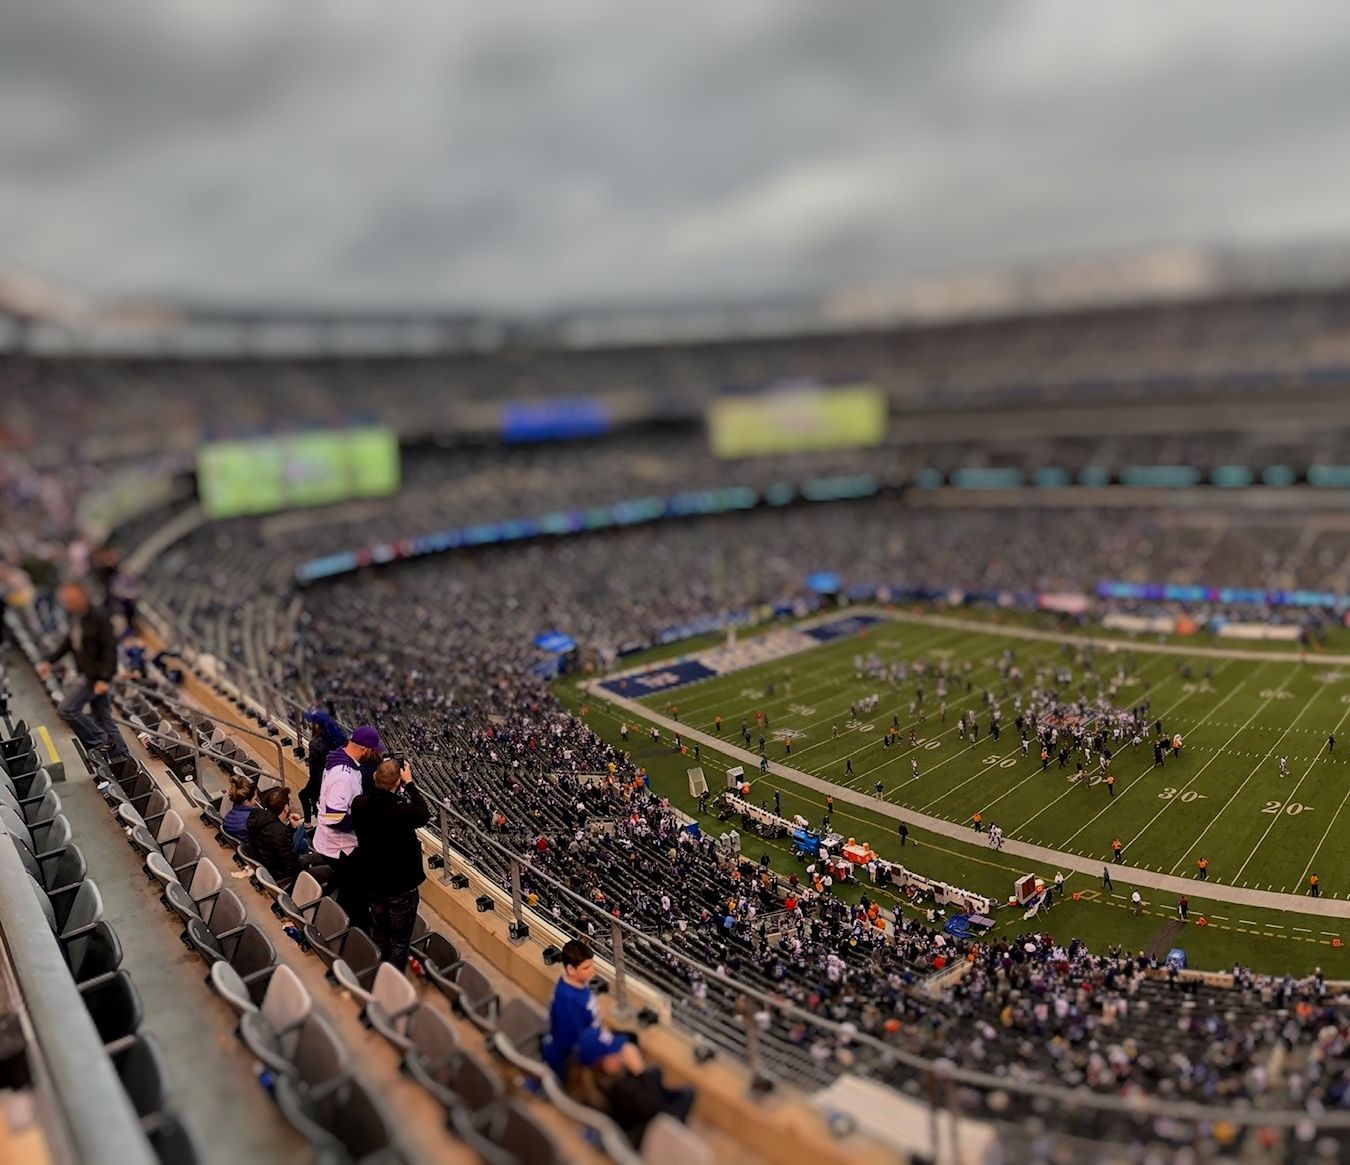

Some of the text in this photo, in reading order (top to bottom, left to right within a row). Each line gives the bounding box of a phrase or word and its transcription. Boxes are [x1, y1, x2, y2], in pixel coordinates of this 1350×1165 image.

[982, 755, 1017, 768] 50
[1158, 787, 1198, 802] 30
[1261, 801, 1305, 816] 20
